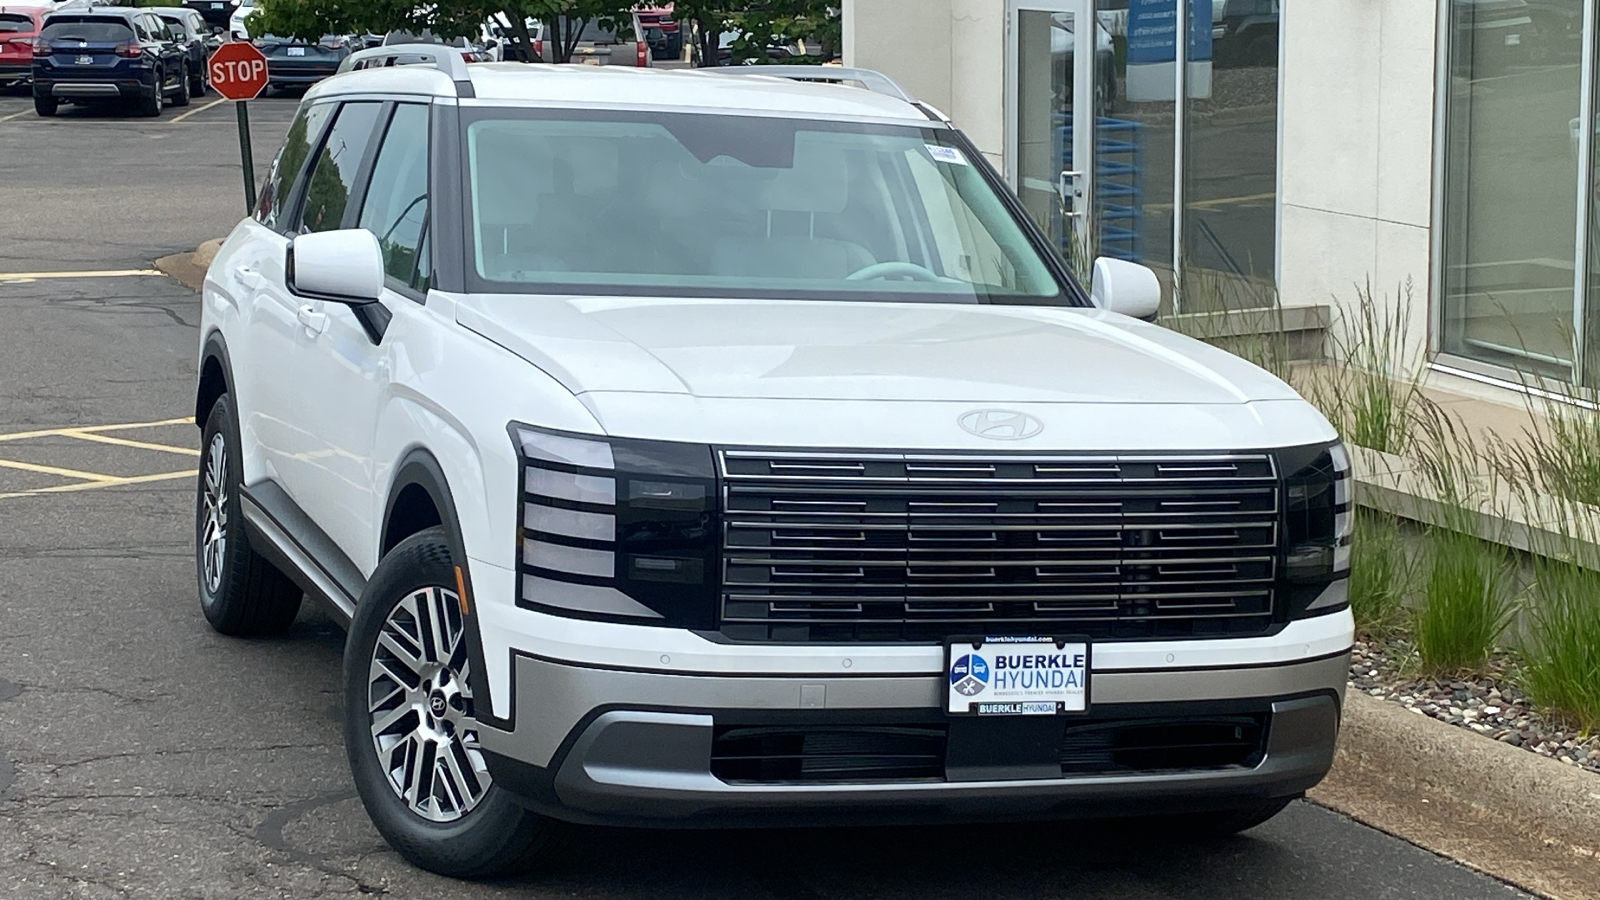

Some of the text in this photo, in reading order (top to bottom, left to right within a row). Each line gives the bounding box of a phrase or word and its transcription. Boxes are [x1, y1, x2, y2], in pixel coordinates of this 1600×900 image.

[212, 59, 264, 84] STOP
[995, 654, 1085, 669] BUERKLE
[994, 669, 1084, 689] HYUNDAI
[979, 703, 1055, 713] BUERKLE HYUNDAI
